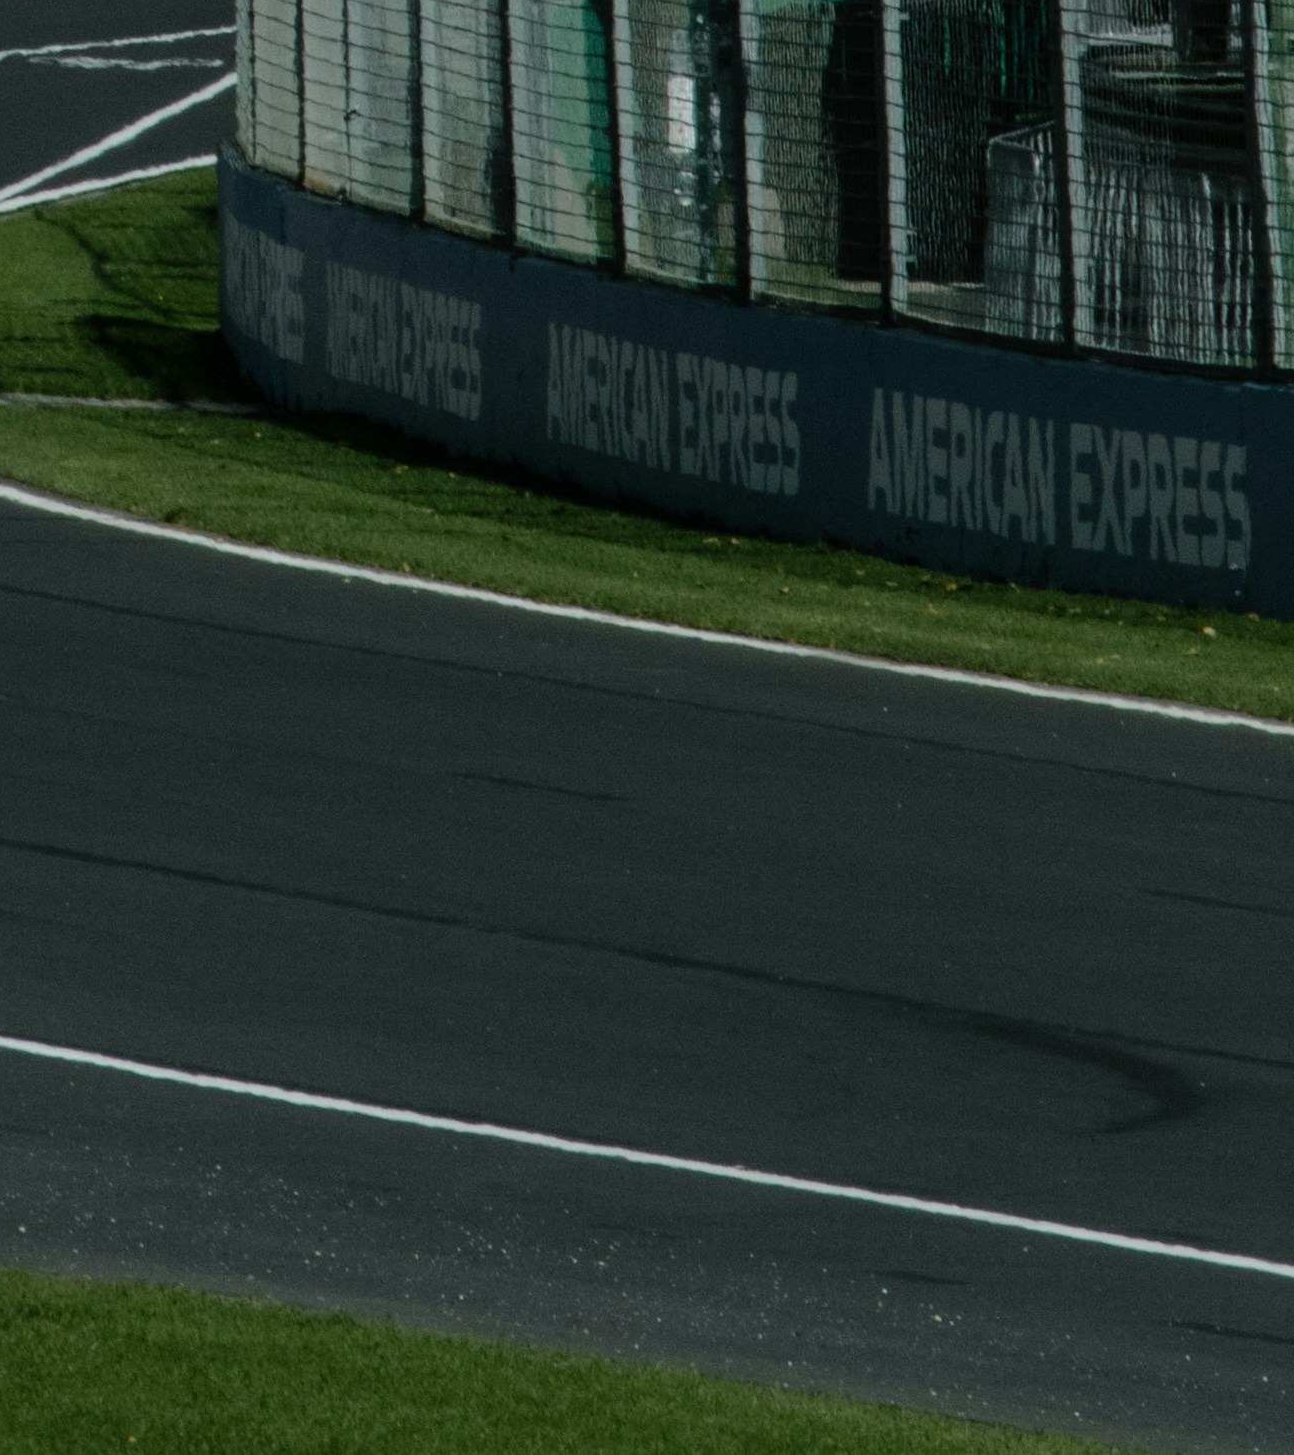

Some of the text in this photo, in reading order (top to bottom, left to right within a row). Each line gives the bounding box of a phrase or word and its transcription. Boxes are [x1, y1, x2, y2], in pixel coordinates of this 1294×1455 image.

[546, 323, 801, 496] AMERICAN EXPRESS
[868, 388, 1252, 571] AMERICAN EXPRESS
